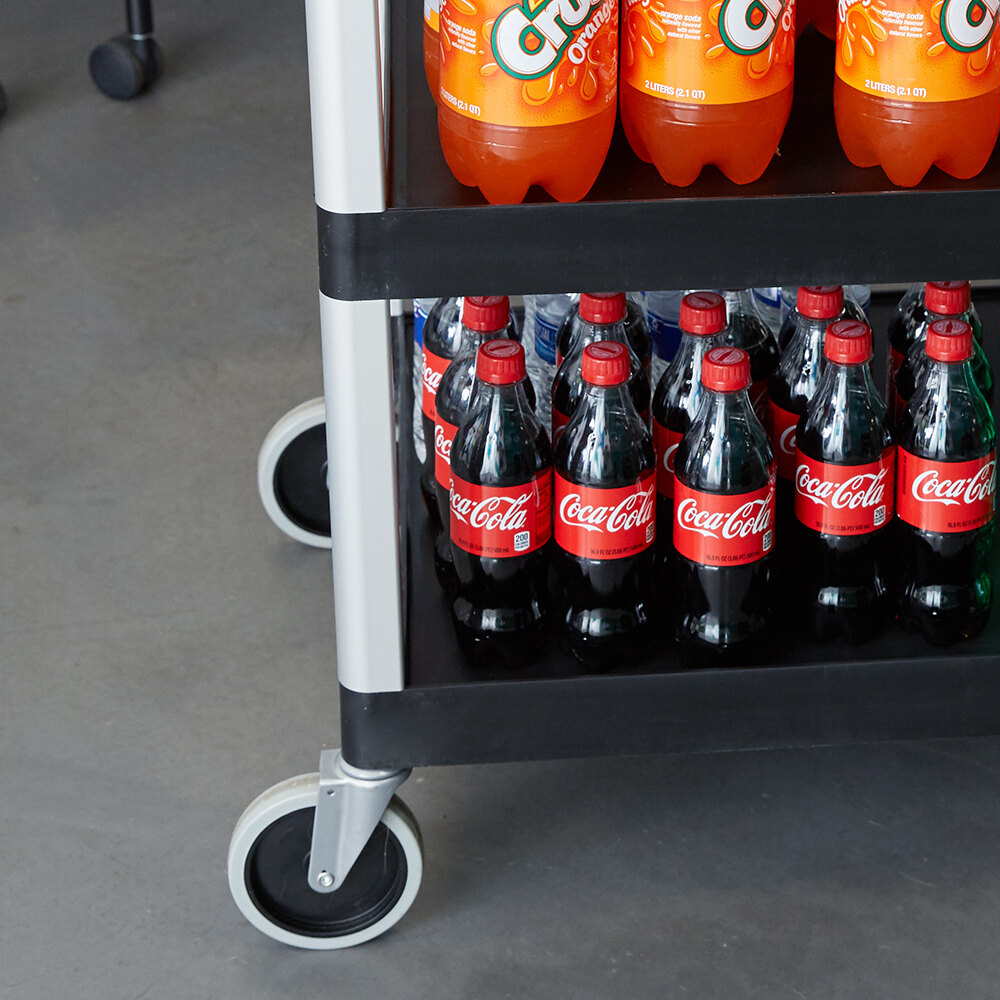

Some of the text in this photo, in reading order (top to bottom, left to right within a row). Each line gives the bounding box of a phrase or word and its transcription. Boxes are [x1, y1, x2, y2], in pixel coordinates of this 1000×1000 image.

[660, 10, 683, 20] orange
[882, 9, 905, 19] orange
[645, 80, 706, 100] 2 LITERS (2.1 QT)
[865, 79, 927, 98] 2 LITERS (2.1 QT)
[795, 464, 889, 510] Coca-Cola
[449, 478, 534, 531] oca-Cola
[560, 484, 655, 533] Coca-Cola
[677, 492, 773, 539] Coca-Cola
[515, 533, 529, 543] 200
